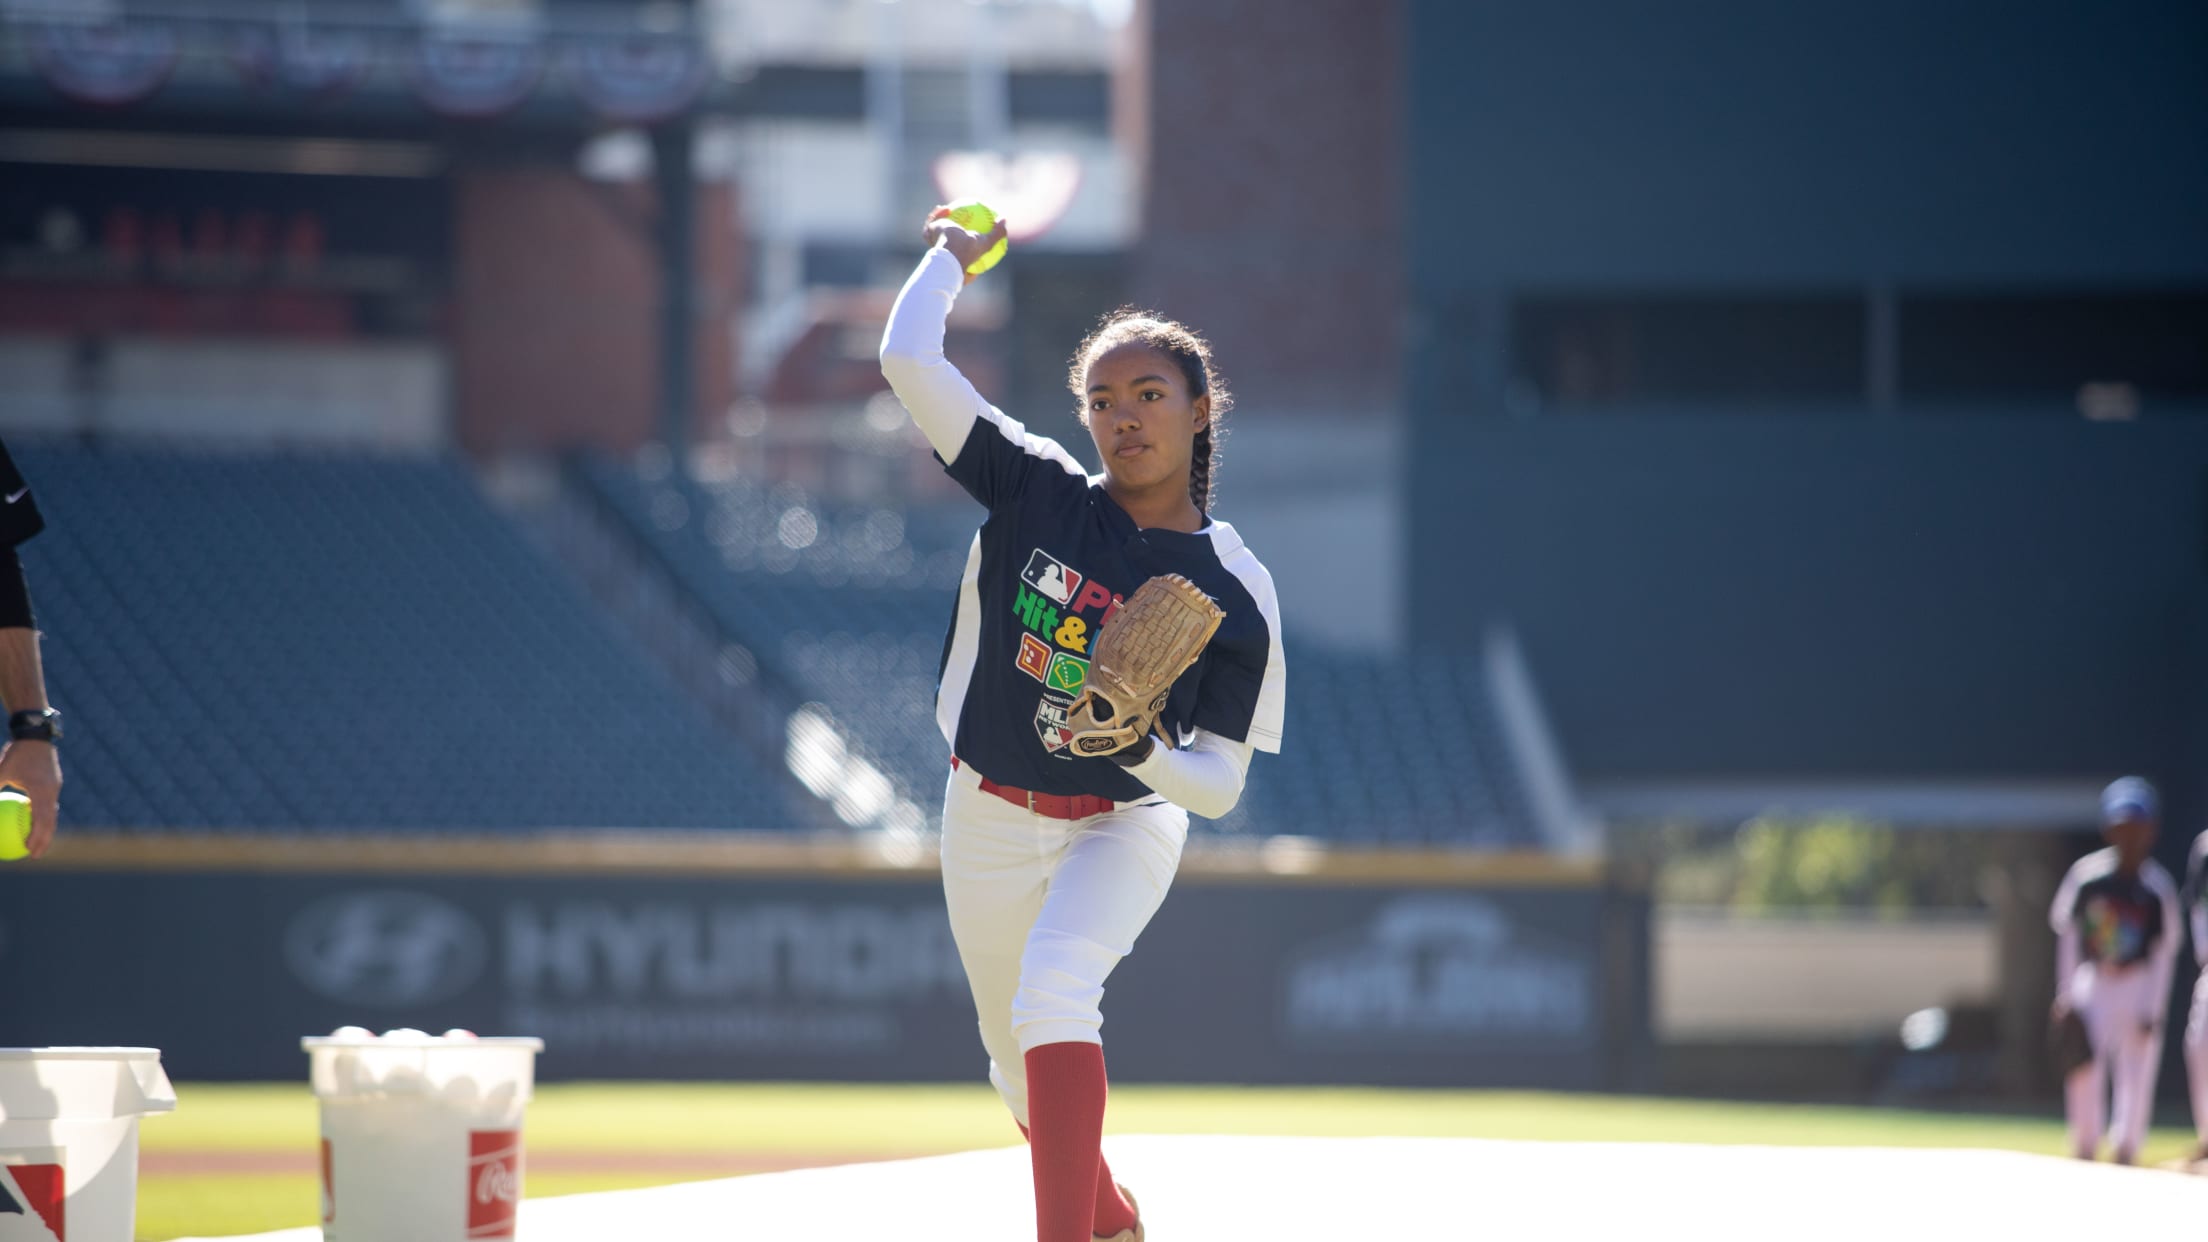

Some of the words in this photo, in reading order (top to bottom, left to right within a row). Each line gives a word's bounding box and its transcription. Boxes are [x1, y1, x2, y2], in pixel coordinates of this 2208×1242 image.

[1012, 581, 1059, 642] Hit
[1055, 616, 1088, 654] &
[506, 902, 970, 994] HYUNDA
